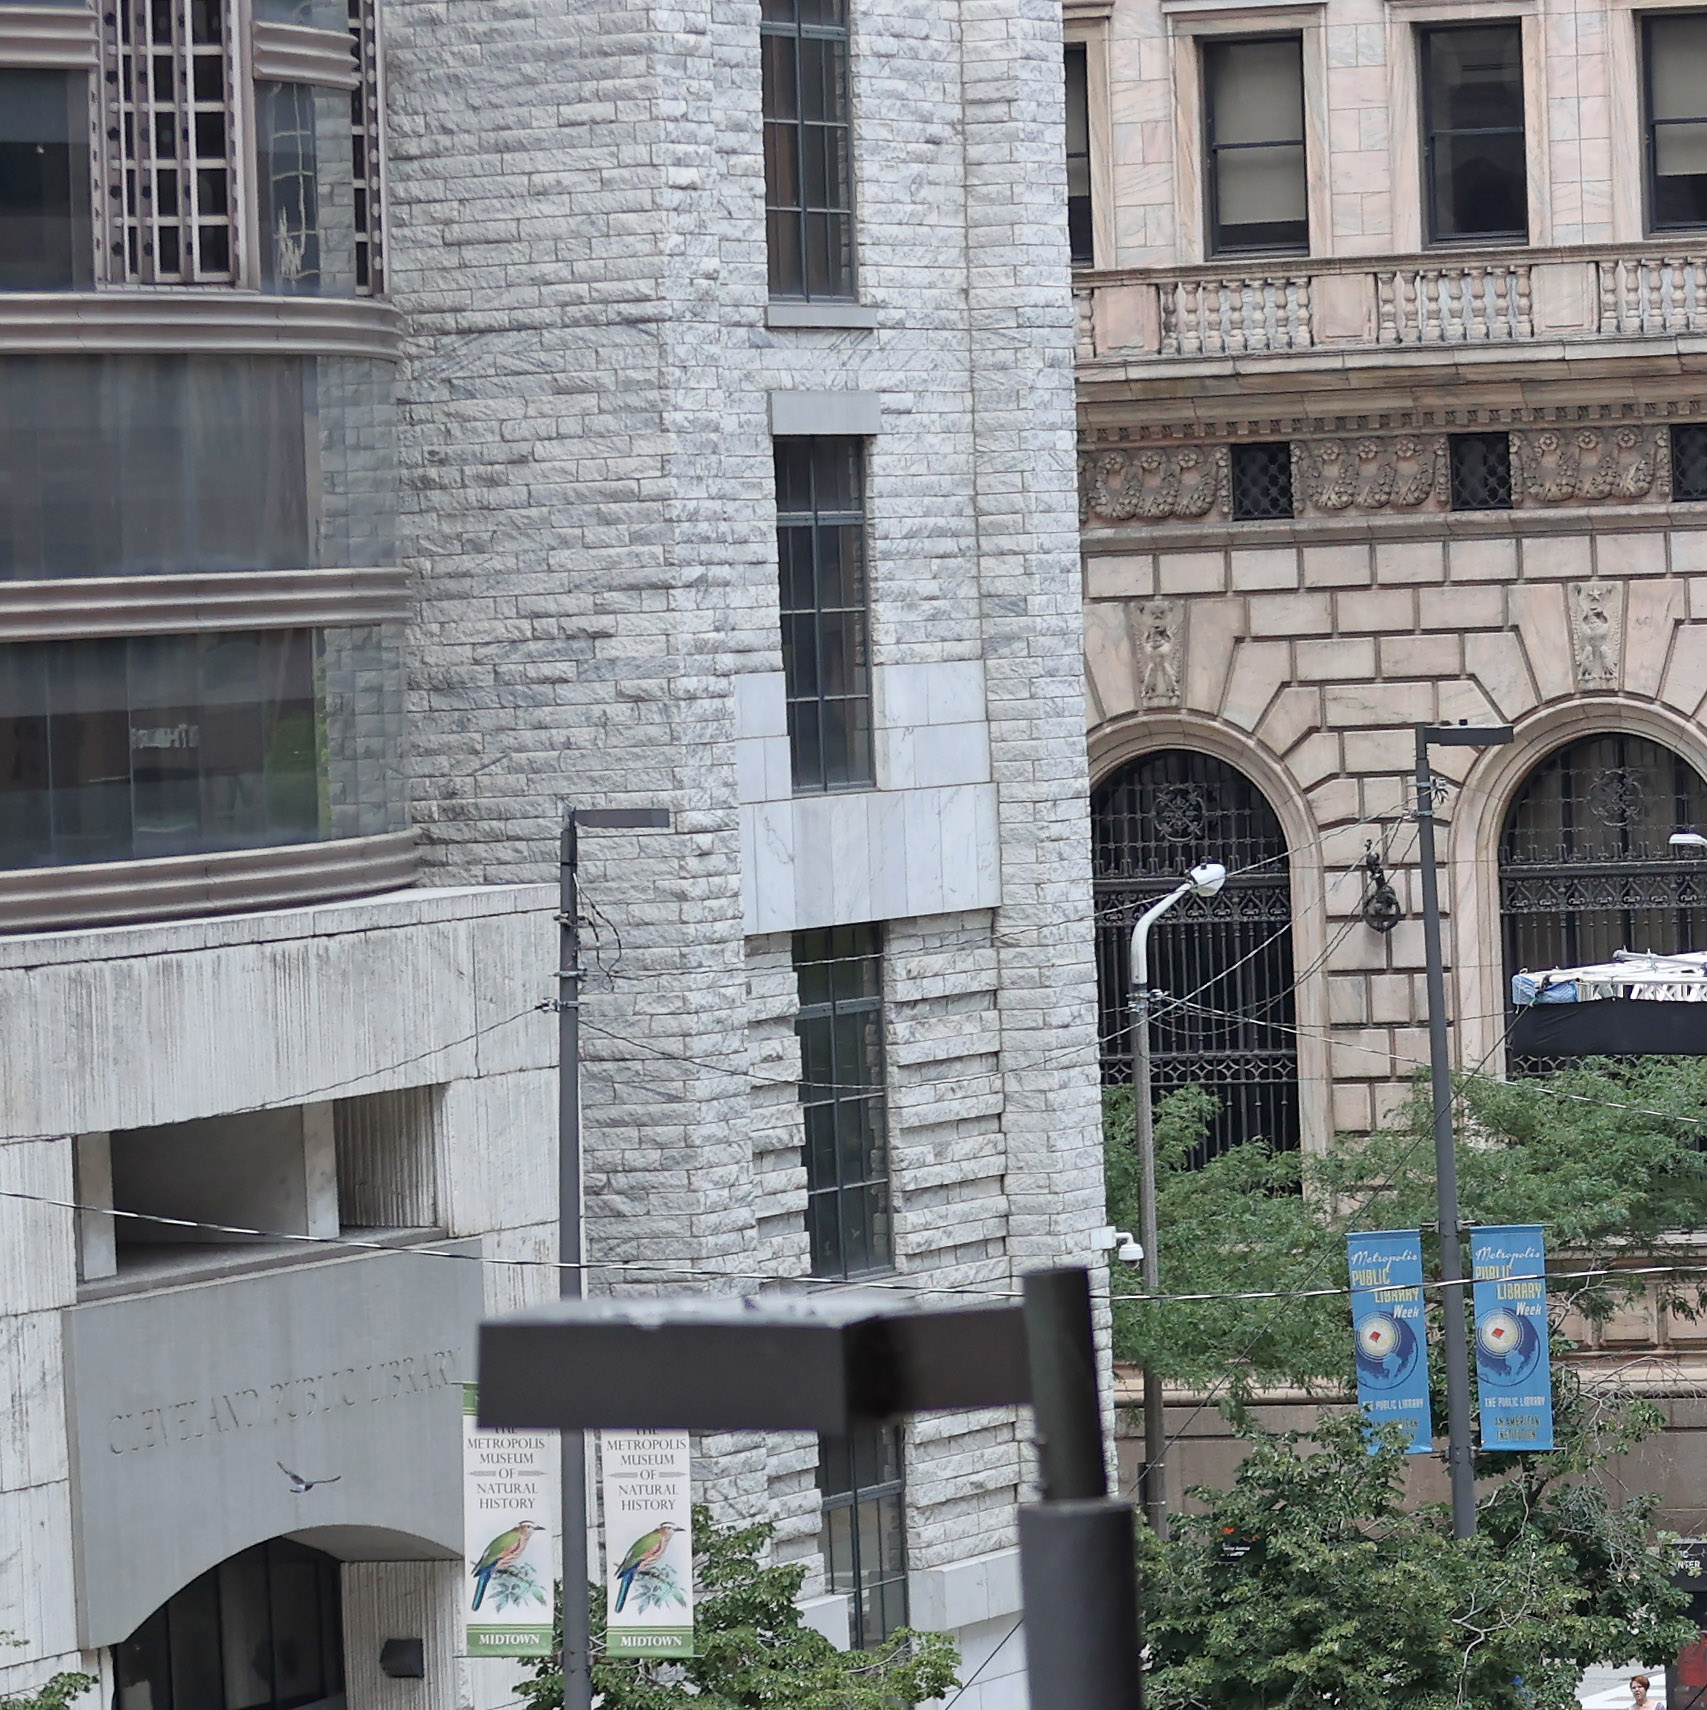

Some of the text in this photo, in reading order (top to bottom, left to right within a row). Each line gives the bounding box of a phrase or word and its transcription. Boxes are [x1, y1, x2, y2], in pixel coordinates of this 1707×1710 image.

[1351, 1250, 1418, 1269] Metropolis
[1474, 1247, 1541, 1267] Metropolis
[1351, 1266, 1390, 1286] PUBLIC
[1373, 1288, 1420, 1303] LIBRARY
[1496, 1283, 1542, 1300] LIBRARY
[1393, 1304, 1420, 1319] Week
[1516, 1301, 1542, 1316] Week
[110, 1347, 462, 1455] CLEVELAND PUBLIC LIBRARY
[1375, 1399, 1397, 1410] PUBLIC
[1399, 1398, 1424, 1409] LIBRARY
[1484, 1396, 1545, 1408] THE PUBLIC LIBRARY
[467, 1438, 545, 1449] METROPOLIS
[607, 1439, 687, 1450] METROPOLIS
[479, 1453, 534, 1464] MUSEUM
[620, 1454, 675, 1465] MUSEUM
[498, 1468, 517, 1479] OF
[639, 1469, 657, 1480] OF
[477, 1483, 538, 1494] NATURAL
[619, 1484, 679, 1495] NATURAL
[479, 1498, 536, 1510] HISTORY
[621, 1499, 677, 1511] HISTORY
[479, 1634, 540, 1645] MIDTOWN
[620, 1635, 682, 1647] MIDTOWN
